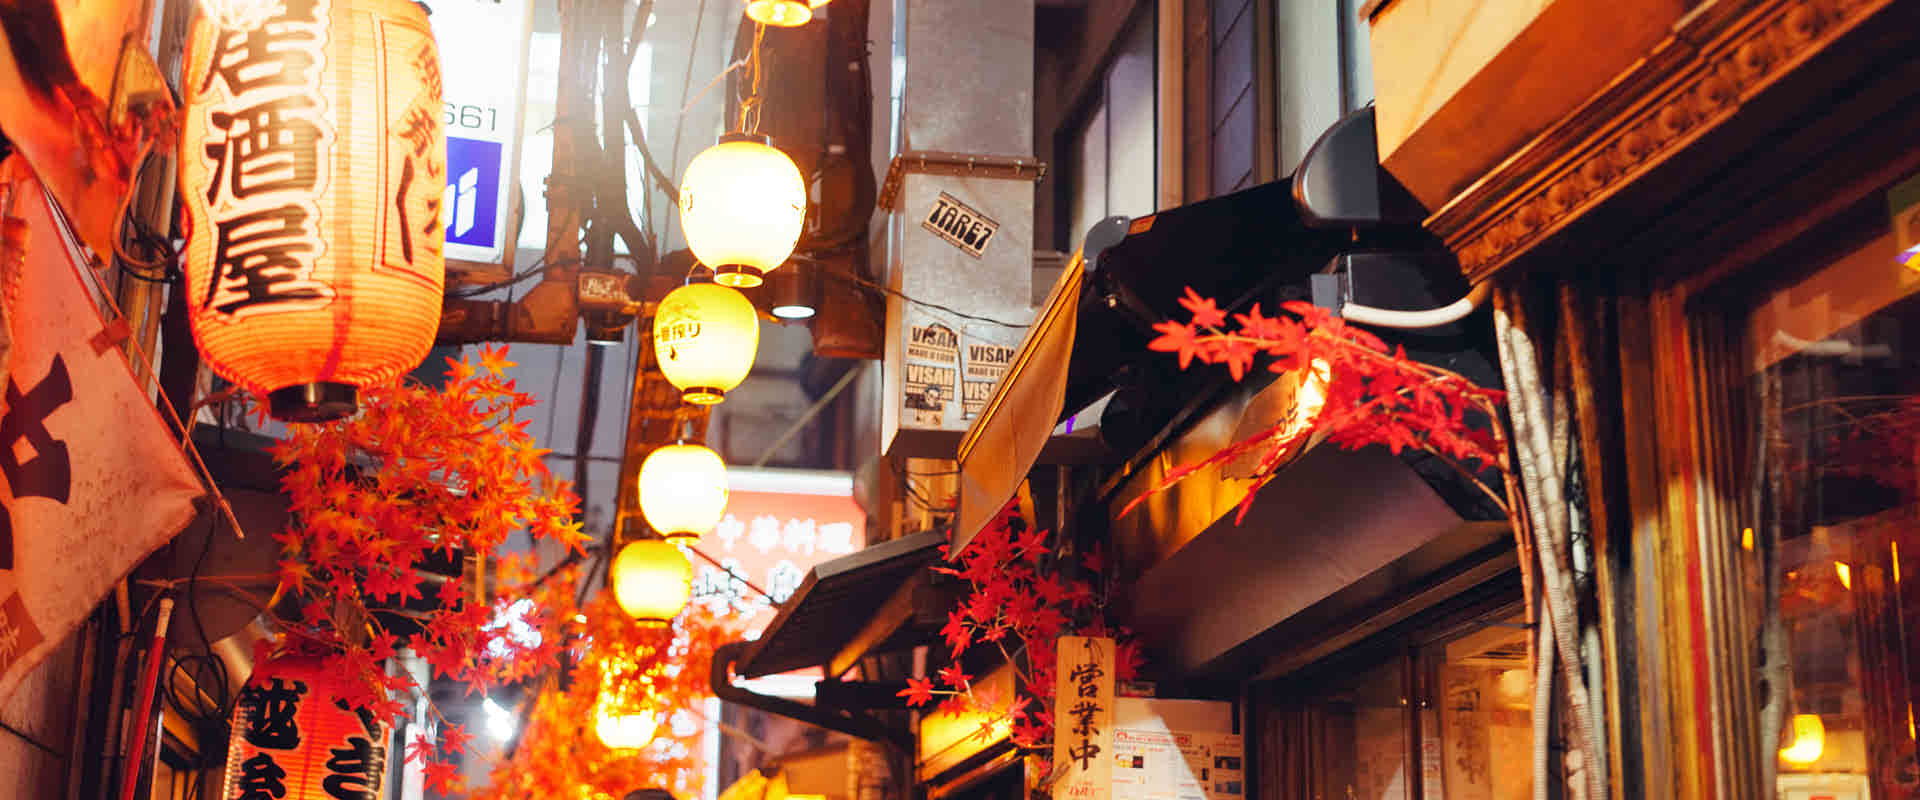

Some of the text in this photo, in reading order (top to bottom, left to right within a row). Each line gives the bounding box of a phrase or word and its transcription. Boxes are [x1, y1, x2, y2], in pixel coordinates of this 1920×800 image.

[199, 0, 334, 316] 居酒屋
[1068, 664, 1105, 771] 営業中
